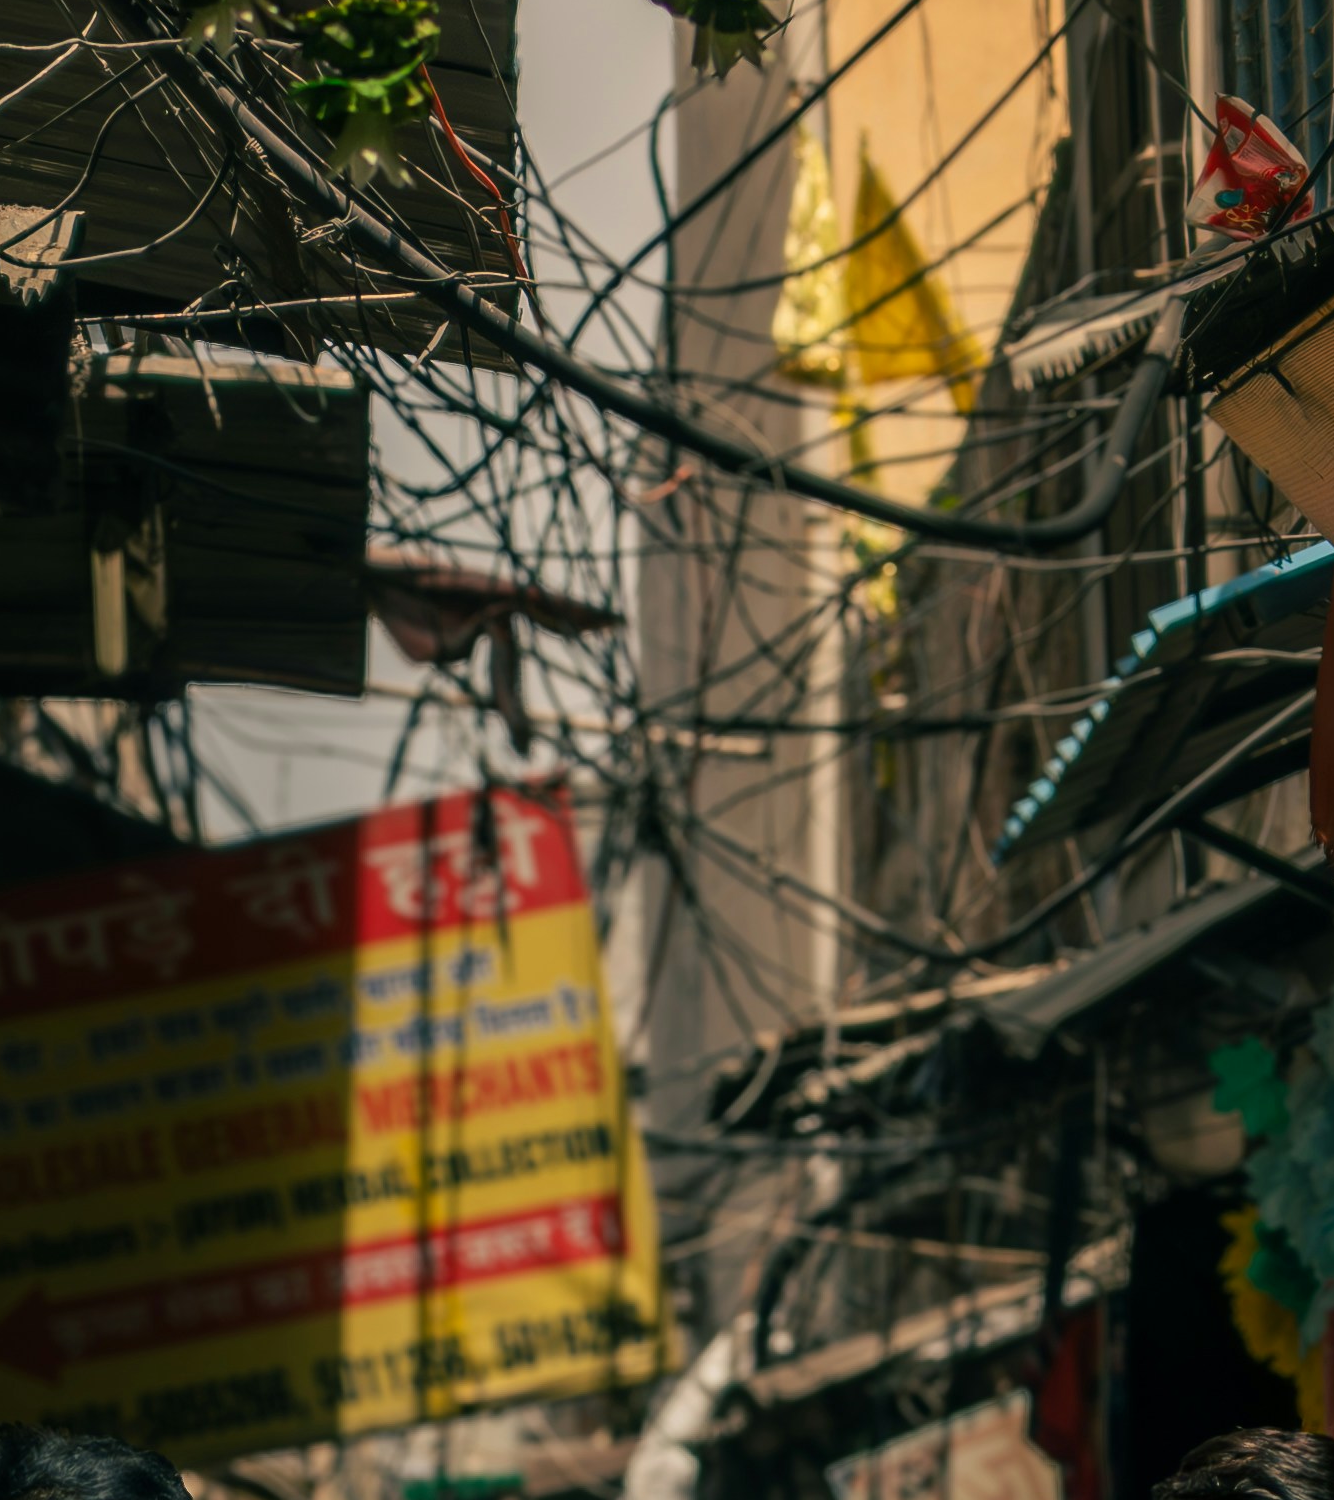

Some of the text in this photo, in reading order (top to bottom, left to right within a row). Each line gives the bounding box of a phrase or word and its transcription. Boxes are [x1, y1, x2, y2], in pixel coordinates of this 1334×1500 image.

[222, 846, 344, 935] दी
[362, 1045, 604, 1134] MERCHANTS
[425, 1125, 615, 1188] COLLECTION
